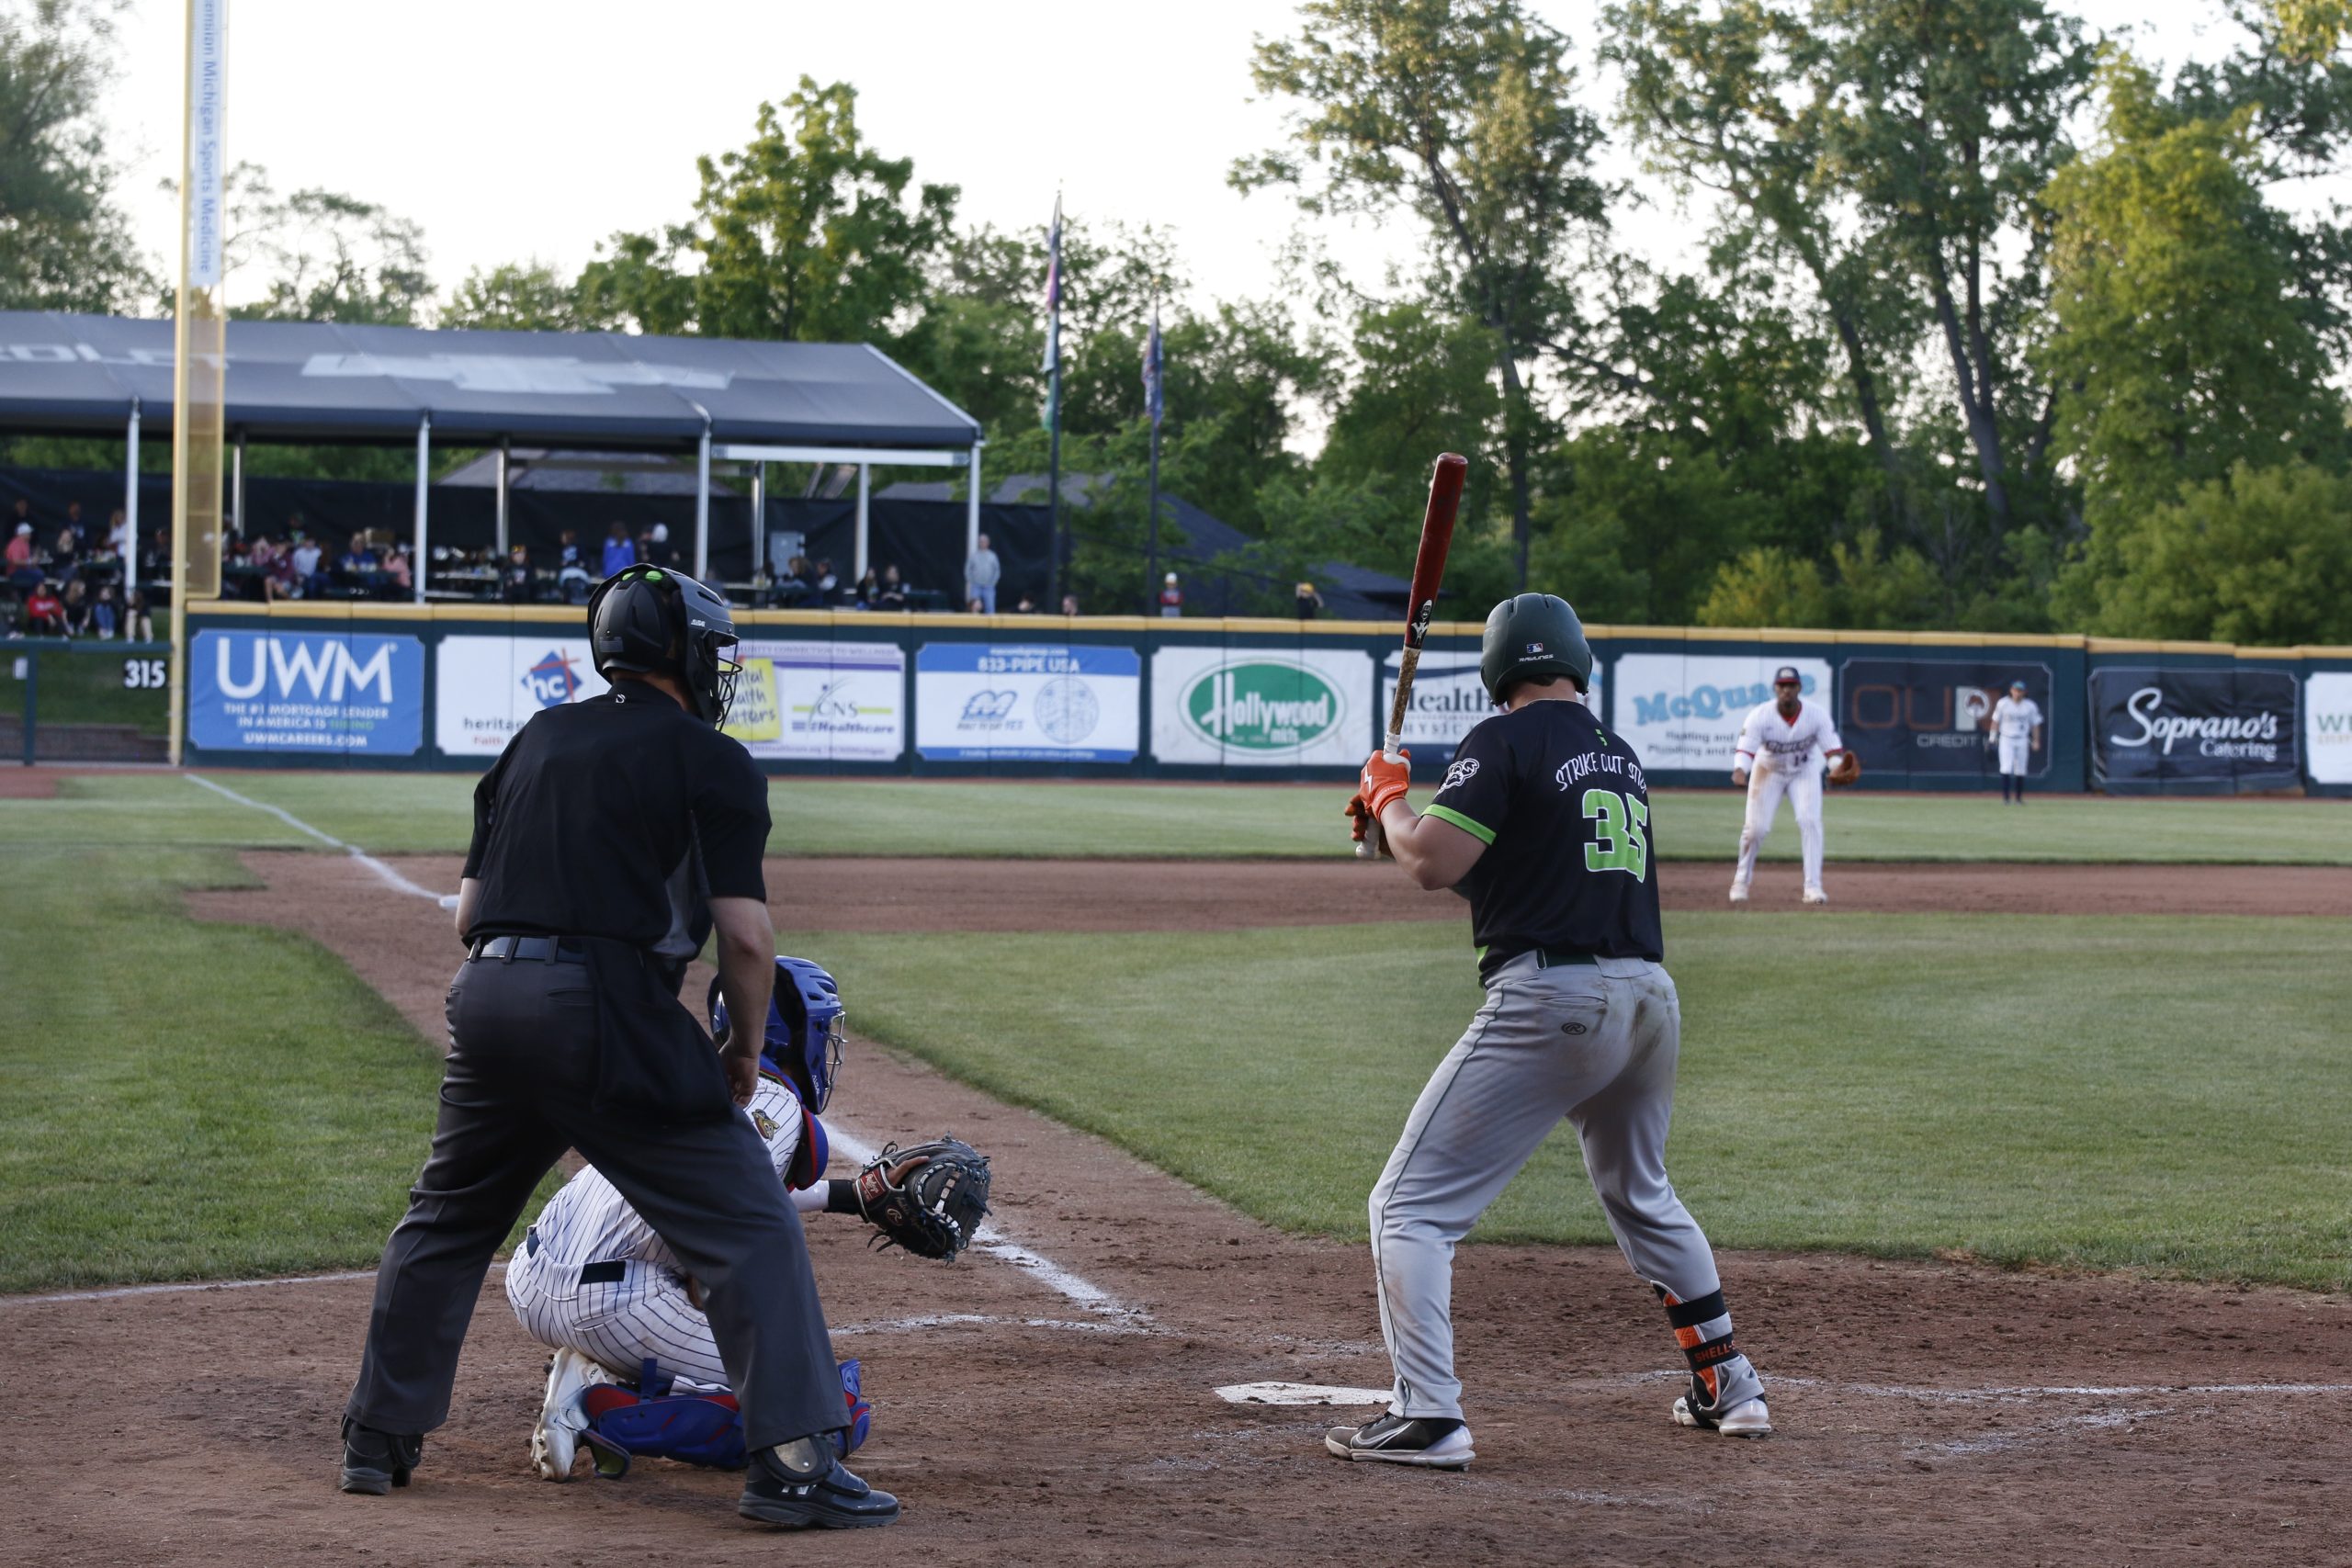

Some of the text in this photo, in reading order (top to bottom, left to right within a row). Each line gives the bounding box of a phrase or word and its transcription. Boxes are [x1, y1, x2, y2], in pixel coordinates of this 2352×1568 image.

[200, 61, 217, 136] Michigan
[200, 140, 217, 192] Sports
[199, 197, 216, 274] Medicine
[1048, 657, 1080, 673] USA
[1519, 653, 1555, 662] RAWLINGS
[123, 659, 166, 689] 315
[216, 637, 393, 704] UWM
[223, 702, 390, 719] THE #1 MORTGAGE LENDER
[816, 701, 858, 718] CNS
[1200, 671, 1330, 738] Hollywood
[237, 716, 253, 728] IN
[256, 716, 311, 728] AMERICA
[725, 709, 775, 726] atters
[2110, 687, 2278, 755] Soprano's
[243, 732, 368, 748] UWMCAREERS.COM
[472, 735, 504, 746] Faith
[1713, 731, 1734, 740] and
[1917, 734, 1976, 748] CREDIT
[2199, 738, 2278, 761] Catering
[1555, 751, 1599, 792] STRIKE
[1600, 753, 1625, 774] OUT
[1581, 788, 1648, 884] 35
